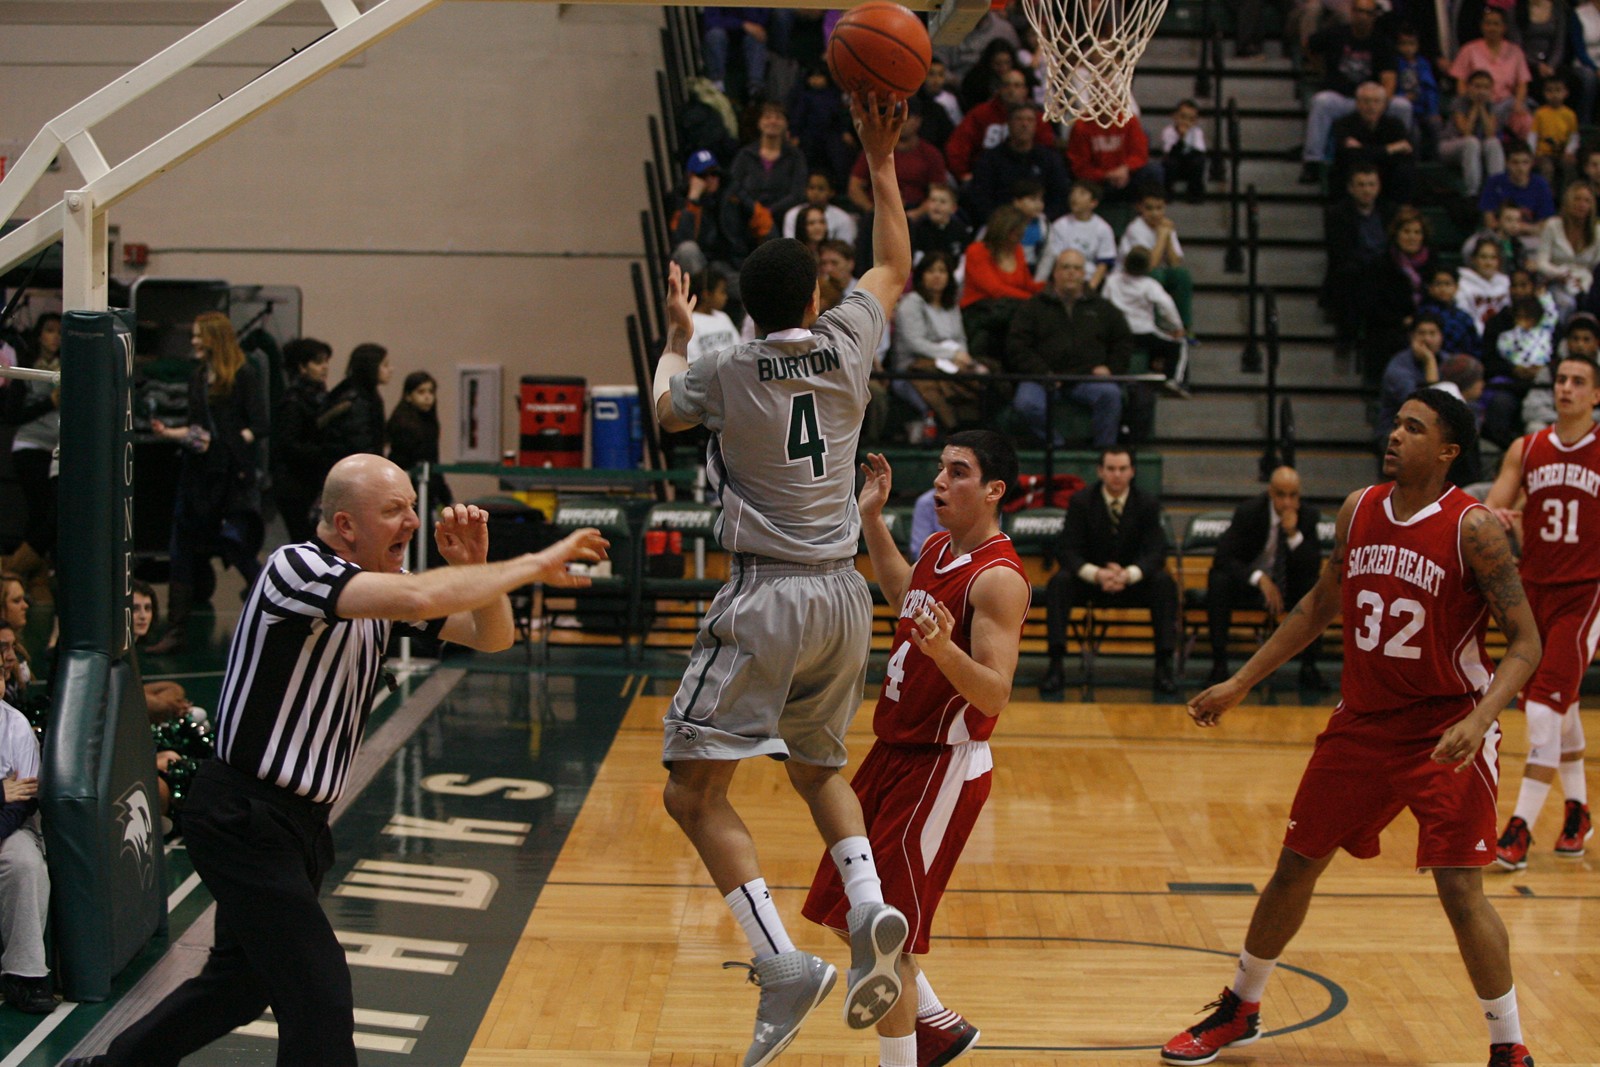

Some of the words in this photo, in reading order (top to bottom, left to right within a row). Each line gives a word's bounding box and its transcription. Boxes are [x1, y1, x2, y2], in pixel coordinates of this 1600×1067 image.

[758, 348, 840, 383] BURTON
[784, 390, 829, 482] 4
[117, 332, 136, 652] WAGNER
[1527, 463, 1566, 495] SACRED
[1564, 463, 1600, 498] HEART
[1540, 498, 1580, 544] 31
[1347, 544, 1397, 579] SACRED
[1394, 547, 1446, 597] HEART
[1355, 589, 1427, 660] 32
[885, 640, 912, 703] 4
